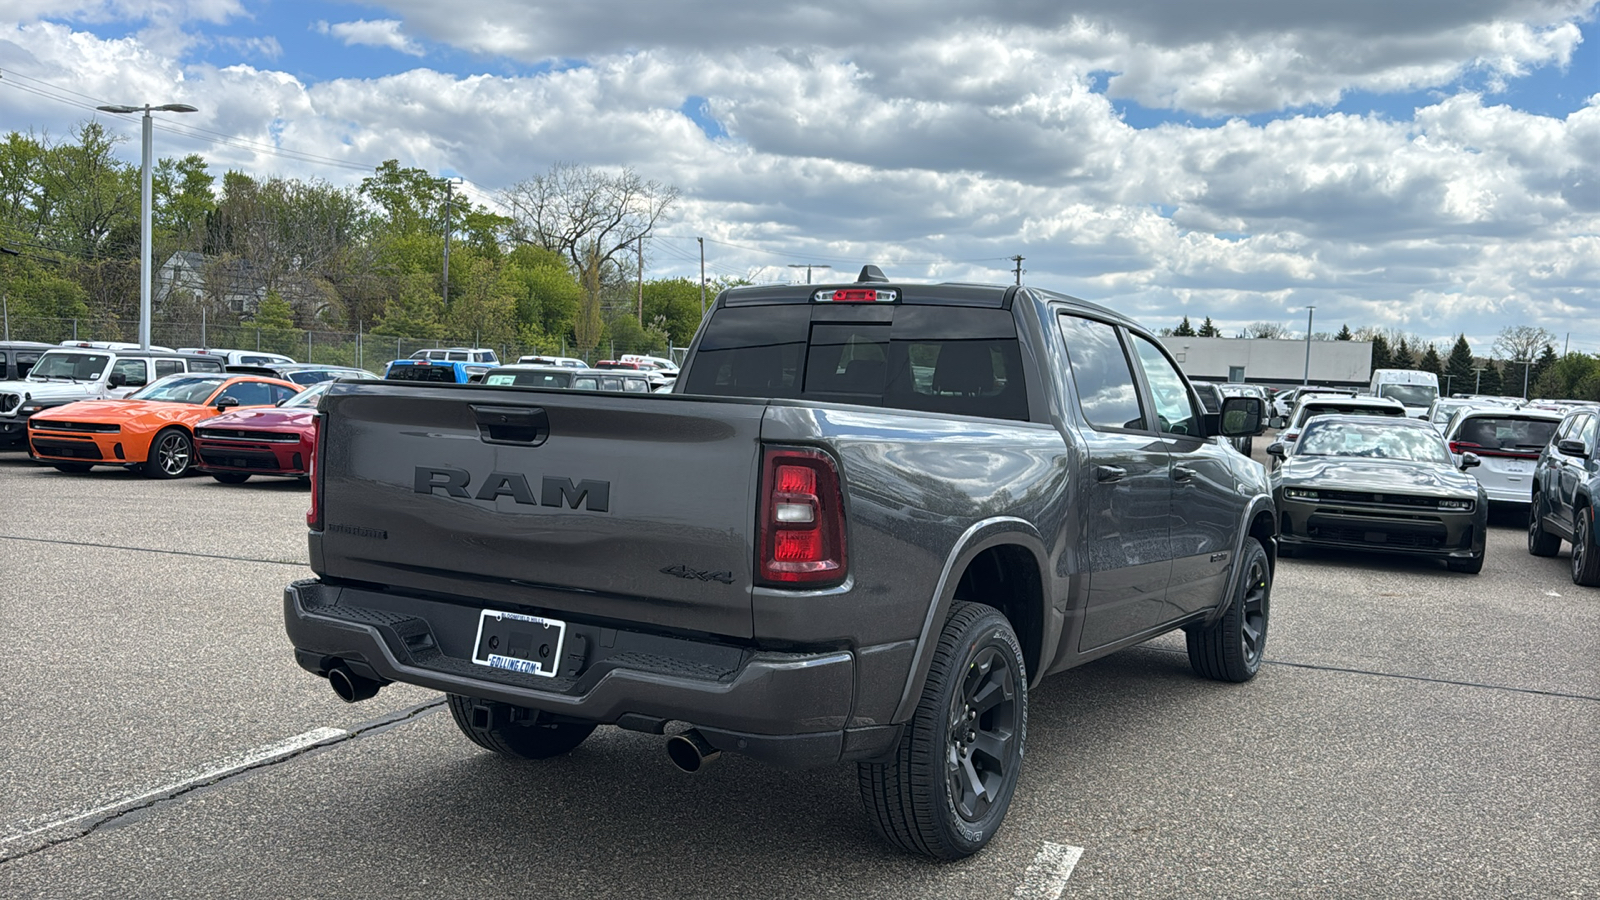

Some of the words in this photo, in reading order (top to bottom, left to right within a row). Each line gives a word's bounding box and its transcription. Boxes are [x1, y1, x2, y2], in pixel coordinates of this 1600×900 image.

[413, 465, 611, 513] RAM
[501, 612, 530, 622] BLOOMFIELD
[490, 655, 537, 674] GOLLING.COM
